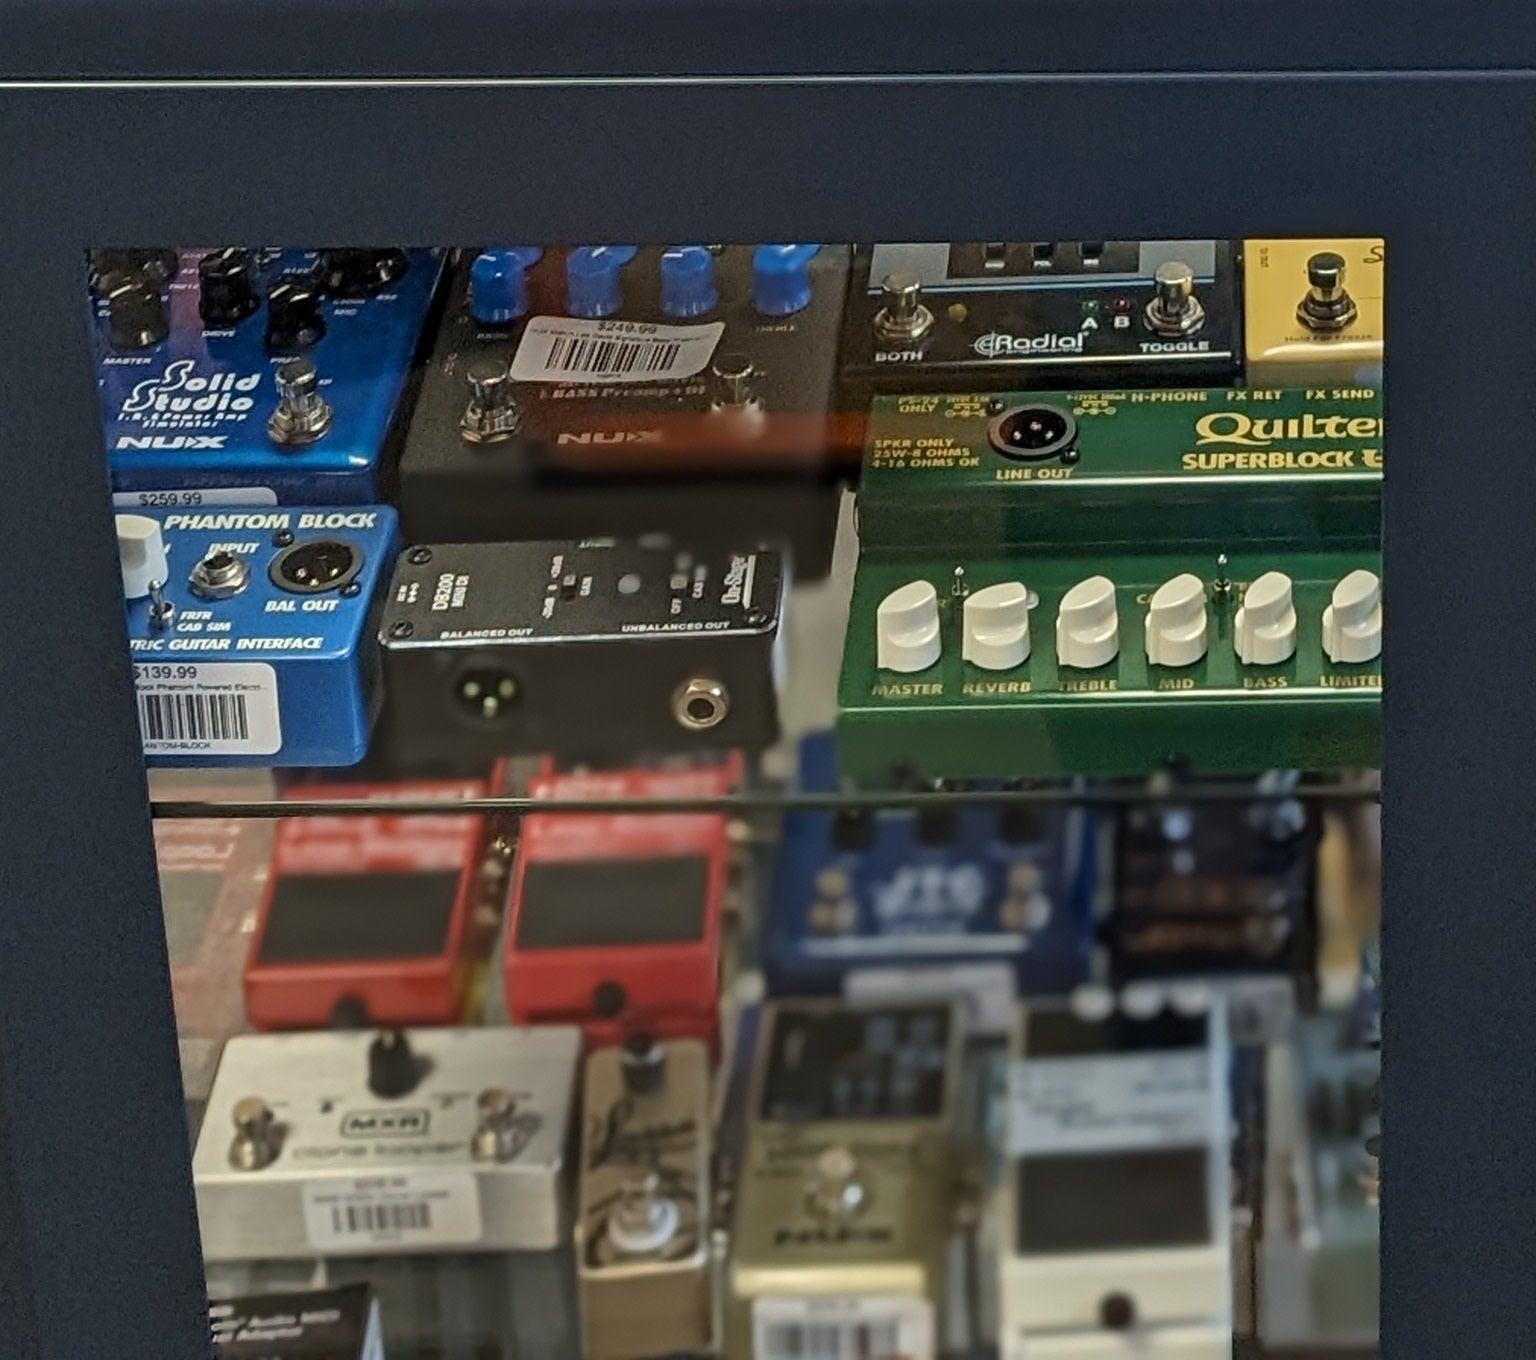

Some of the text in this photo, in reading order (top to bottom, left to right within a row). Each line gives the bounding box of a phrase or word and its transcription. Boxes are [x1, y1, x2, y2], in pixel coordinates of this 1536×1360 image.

[1082, 317, 1098, 329] A
[1114, 316, 1130, 328] B
[994, 333, 1083, 352] Radial
[1139, 341, 1210, 353] TOGGLE
[102, 357, 151, 365] MASTER
[874, 351, 924, 362] BOTH
[158, 360, 262, 392] Solid
[122, 380, 254, 412] Studio
[1131, 391, 1208, 402] H-PHONE
[1227, 389, 1283, 400] FX RET
[1306, 388, 1375, 399] FX SEND
[116, 435, 228, 449] NUX
[875, 438, 953, 449] SPKR ONLY
[926, 447, 971, 457] OHMS
[872, 457, 980, 468] 4-16 OHMS OK
[1181, 449, 1355, 470] SUPERBLOCK
[996, 467, 1075, 480] LINE OUT
[139, 492, 202, 507] $259.99
[164, 513, 377, 530] PHANTOM BLOCK
[209, 543, 260, 555] INPUT
[264, 600, 340, 613] BAL OUT
[176, 621, 231, 632] CAB SIM
[621, 621, 731, 633] UNBALANCED OUT
[440, 627, 534, 640] BALANCED OUT
[168, 637, 231, 651] GUITAR
[236, 637, 324, 650] INTERFACE
[133, 665, 197, 679] $139.99
[872, 682, 944, 696] MASTER
[962, 680, 1033, 694] REVERB
[1059, 679, 1118, 692] TREBLE
[1158, 677, 1195, 690] MID
[1243, 676, 1288, 689] BASS
